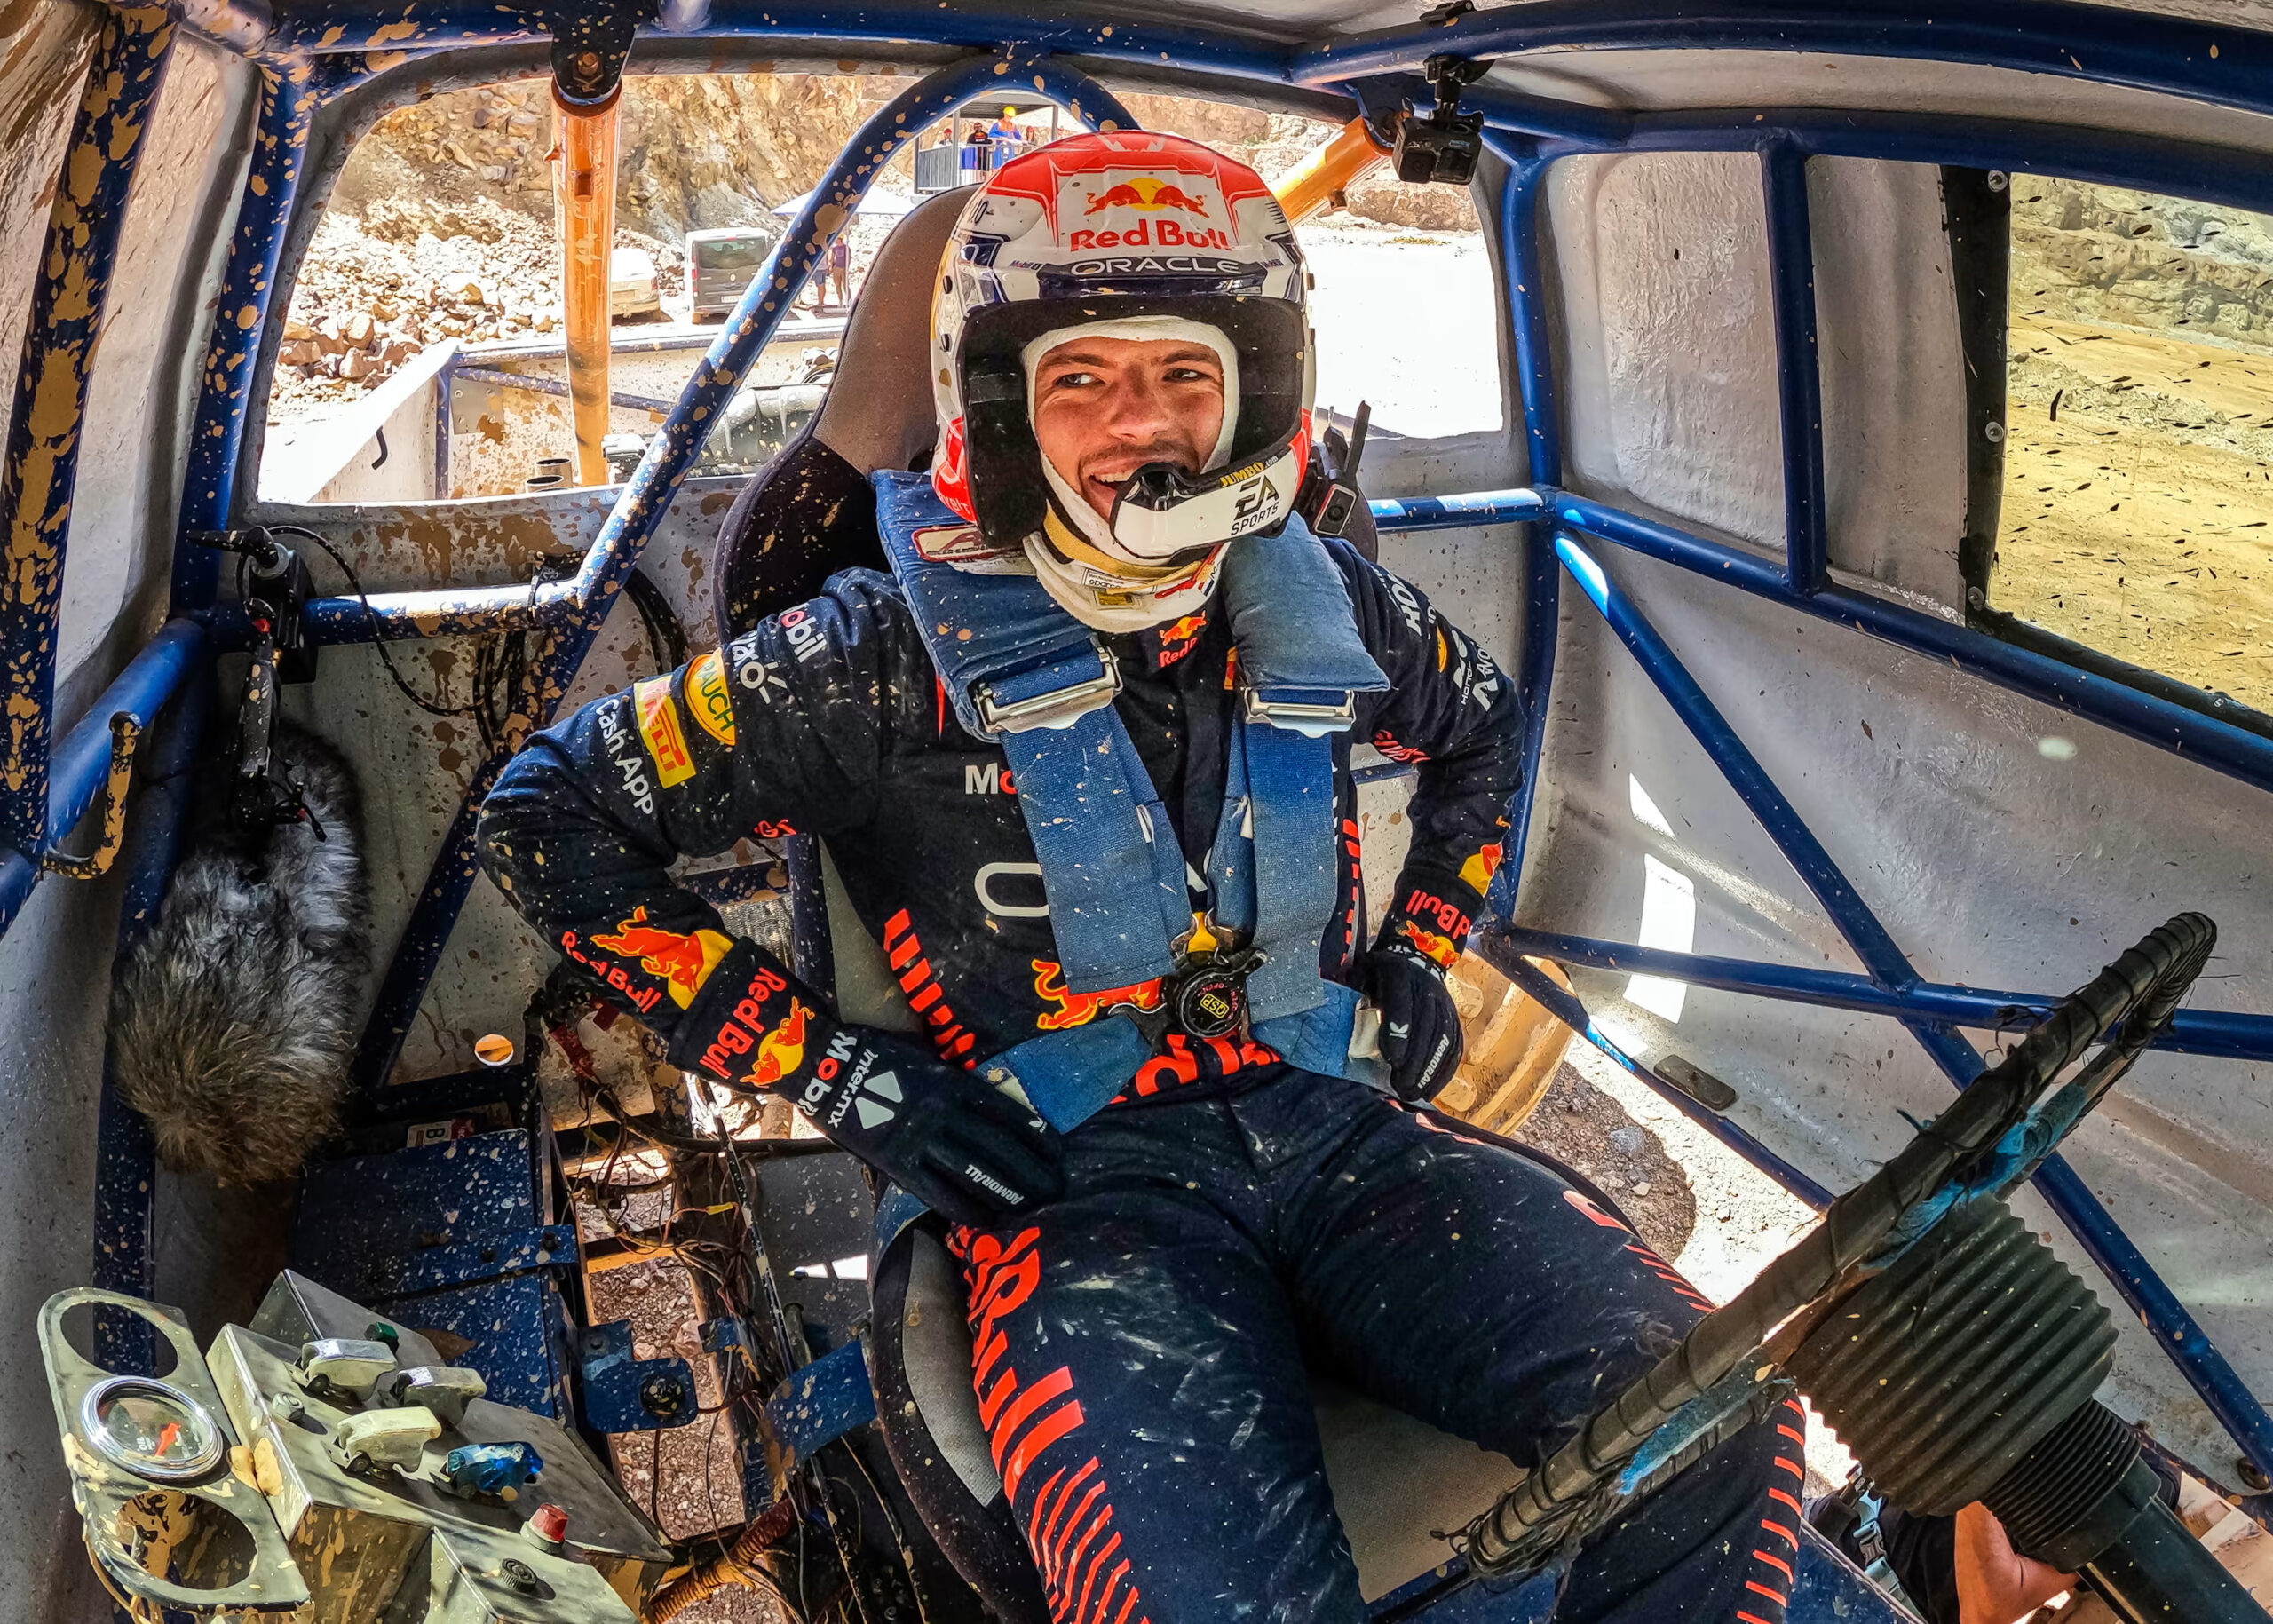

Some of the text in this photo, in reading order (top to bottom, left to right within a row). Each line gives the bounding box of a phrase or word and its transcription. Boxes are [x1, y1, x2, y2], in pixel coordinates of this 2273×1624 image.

[1070, 218, 1232, 252] Red Bull
[1071, 257, 1242, 276] ORACLE
[1231, 501, 1279, 536] SPORTS
[1233, 474, 1279, 521] EA
[1461, 661, 1473, 705] Hond
[596, 698, 654, 815] Cash App
[606, 966, 663, 1014] Bull
[699, 966, 788, 1080] Red Bull
